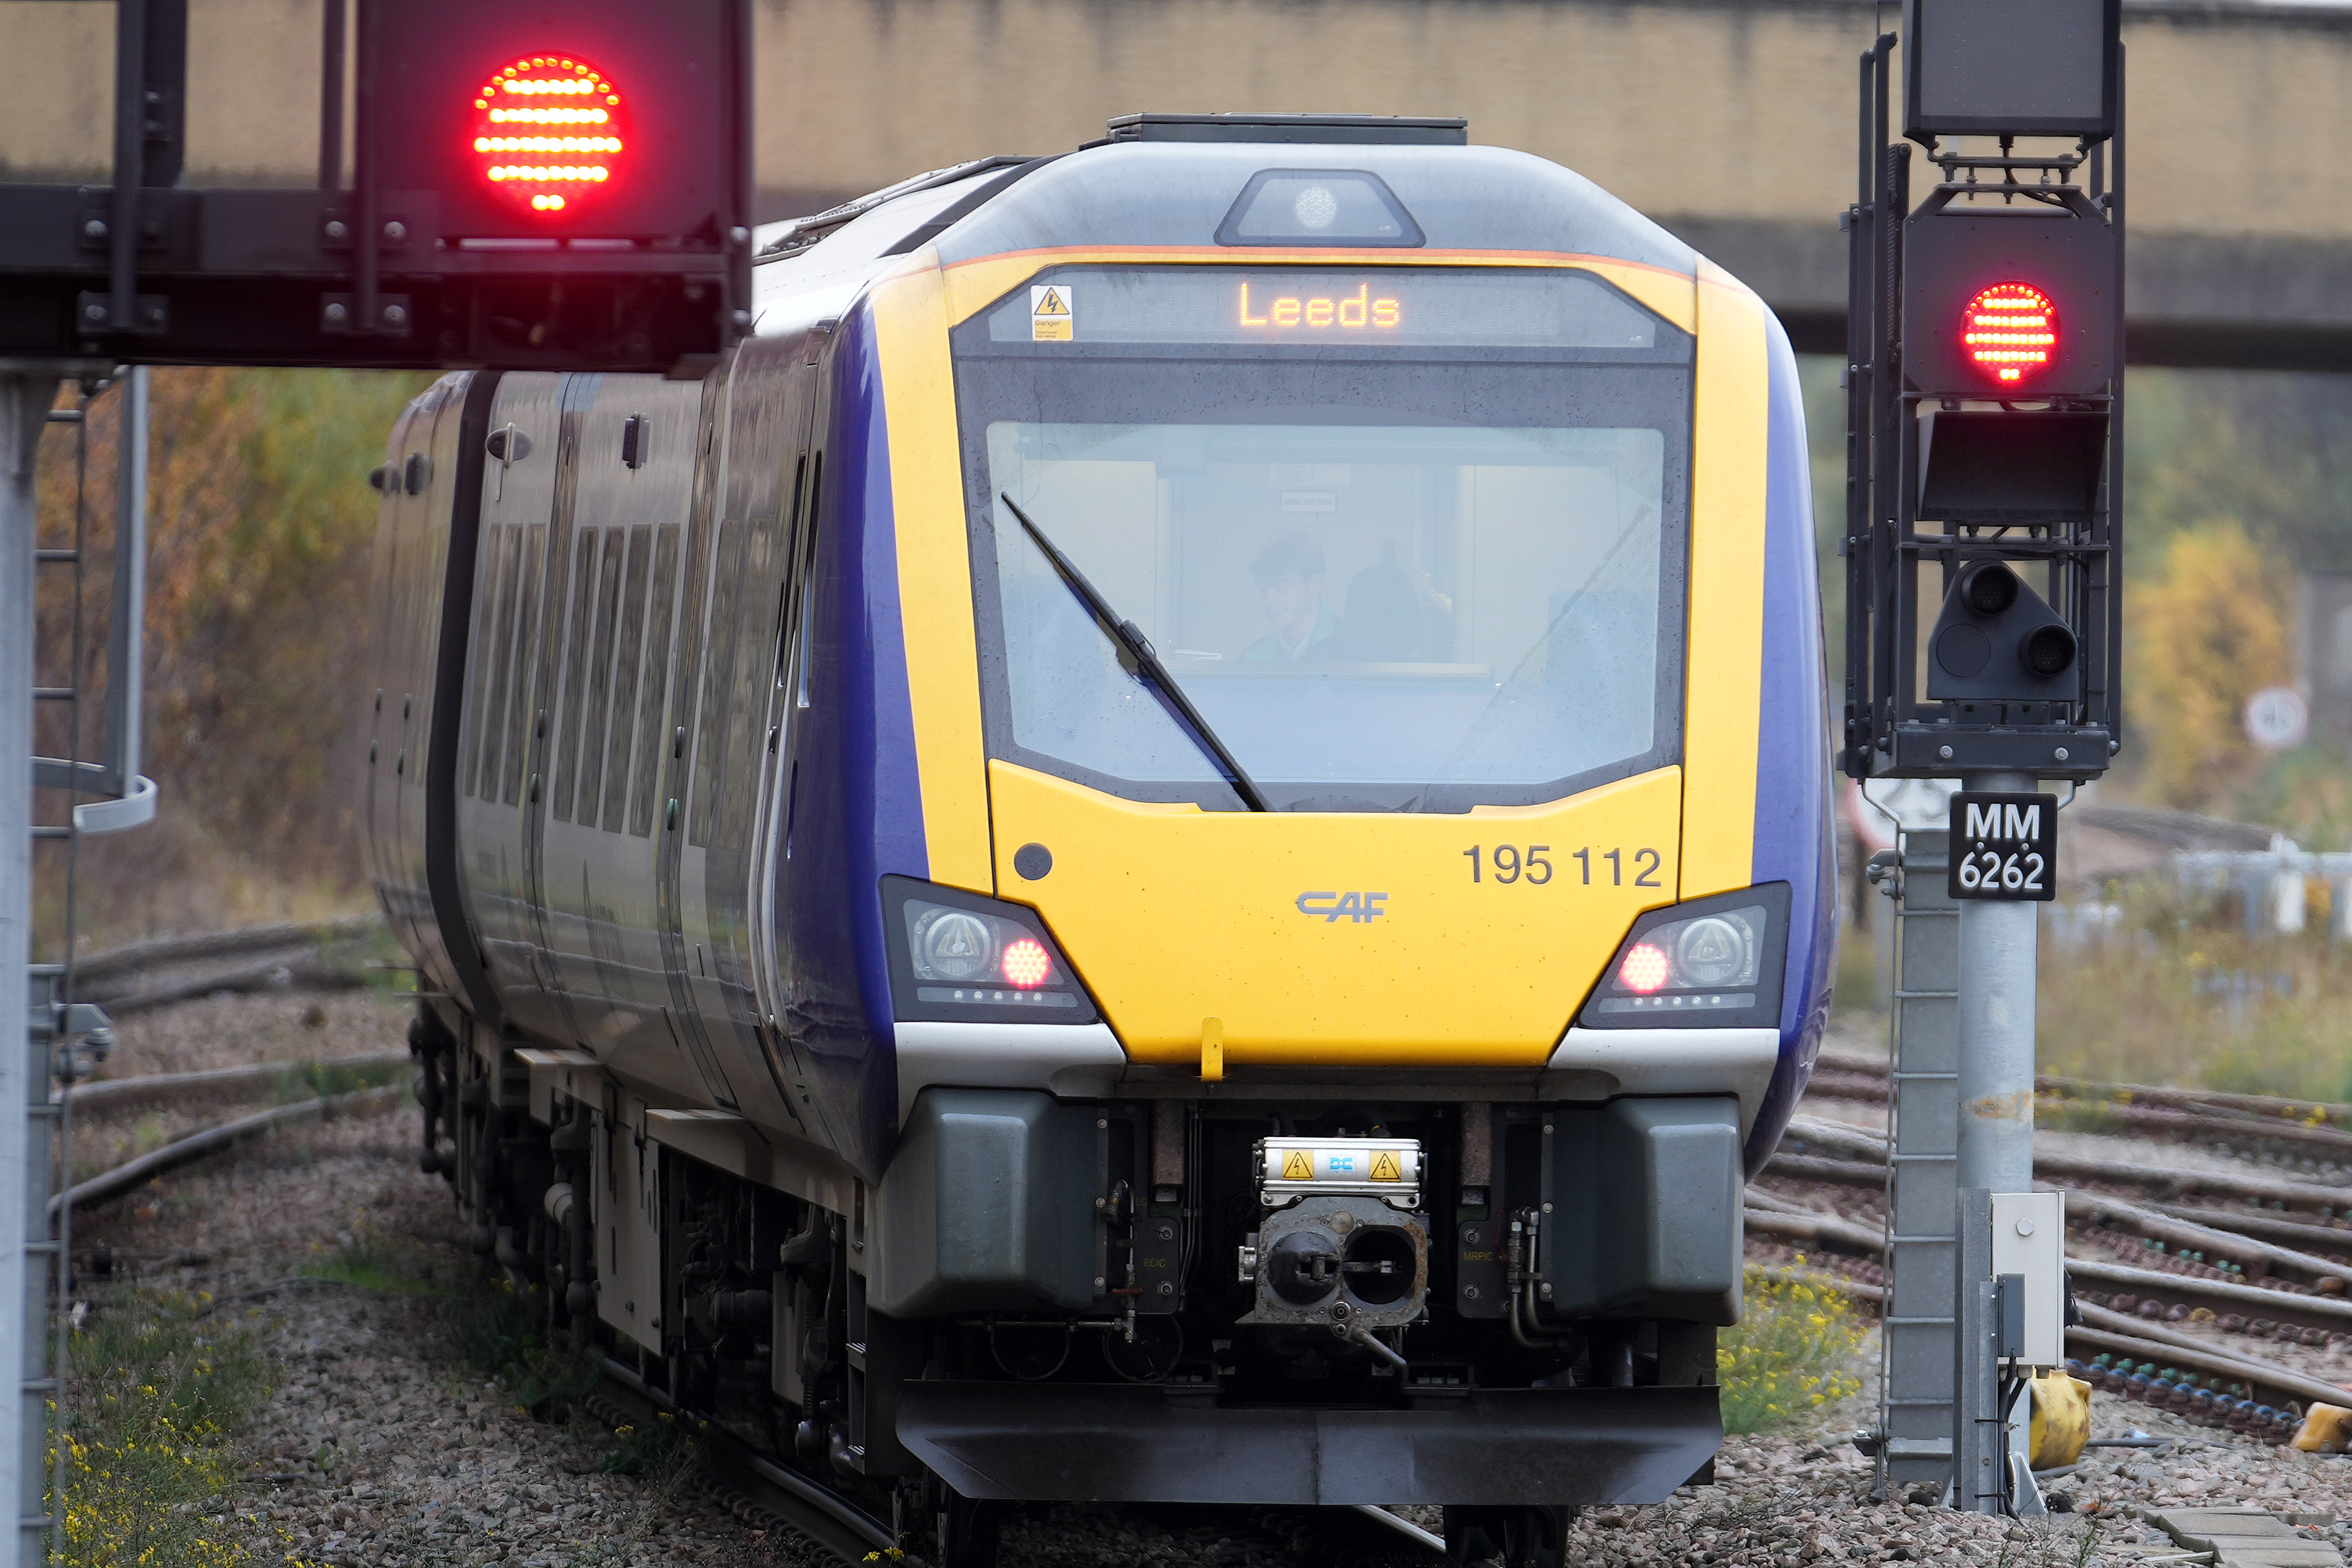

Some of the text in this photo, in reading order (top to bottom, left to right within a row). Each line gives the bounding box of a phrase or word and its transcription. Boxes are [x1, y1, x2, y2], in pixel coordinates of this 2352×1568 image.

[1240, 281, 1401, 327] Leeds
[1966, 803, 2041, 840] MM
[1462, 844, 1662, 887] 195 112
[1959, 851, 2044, 890] 6262
[1296, 891, 1388, 924] CAF
